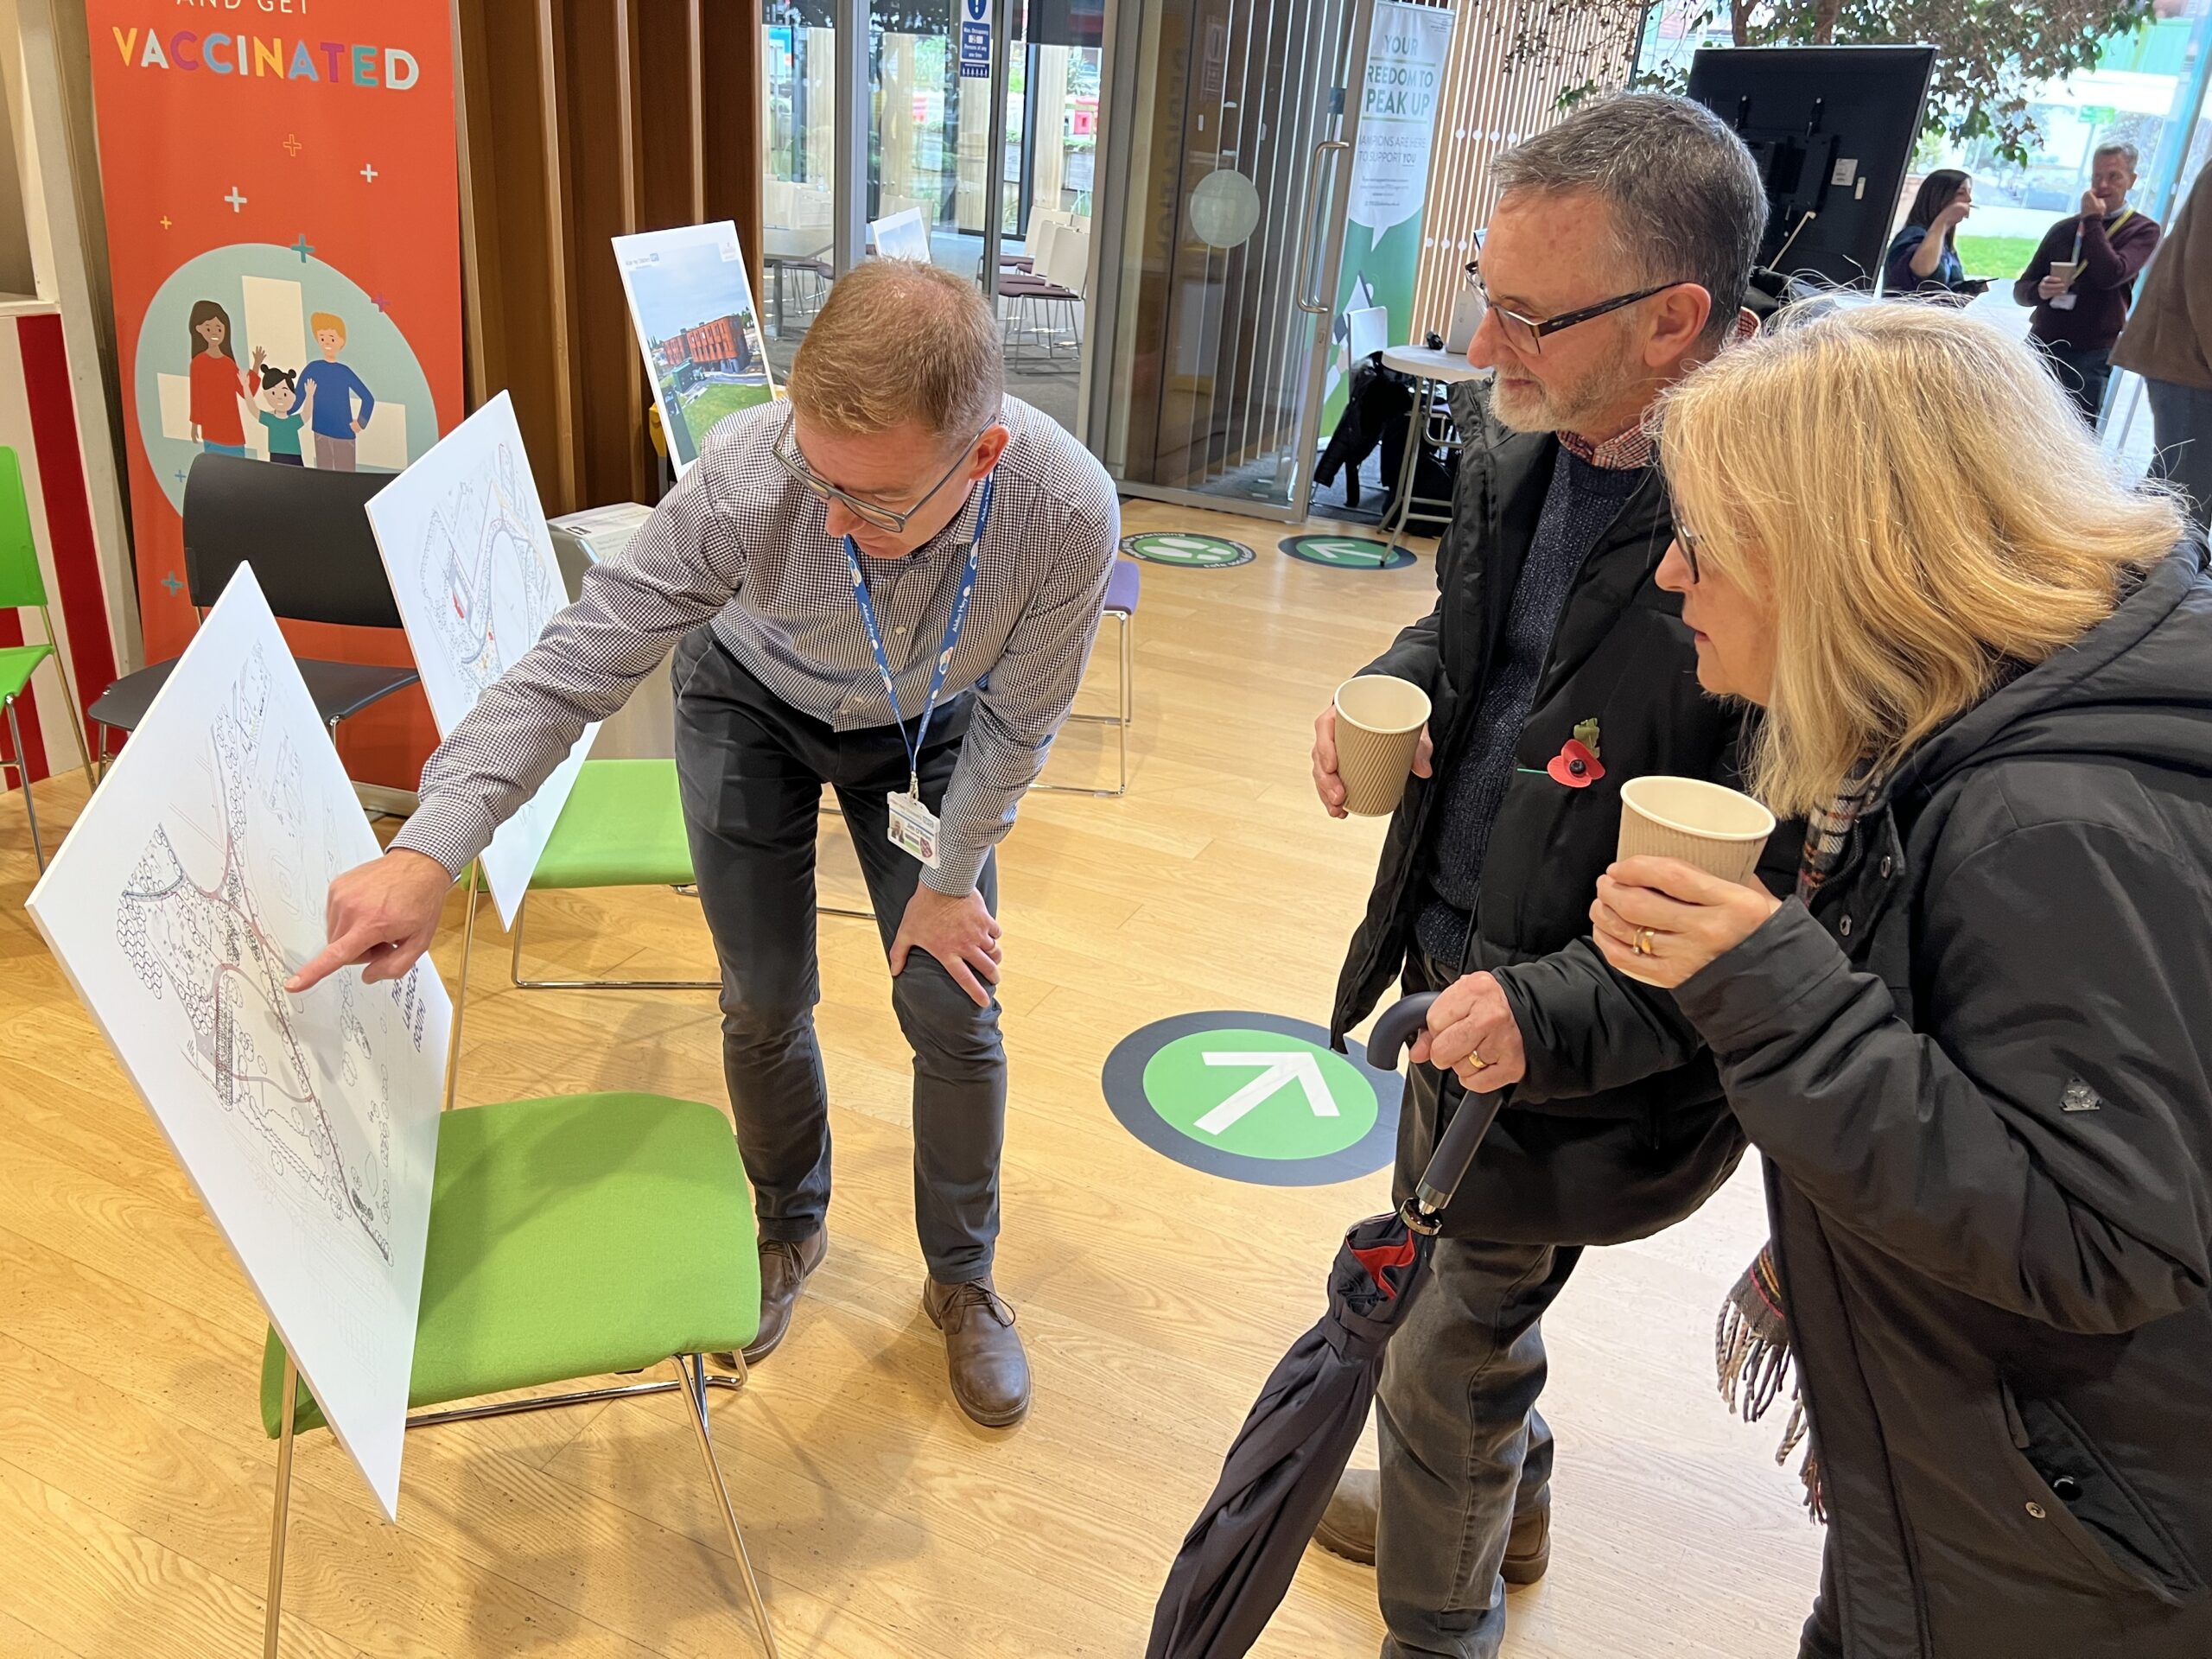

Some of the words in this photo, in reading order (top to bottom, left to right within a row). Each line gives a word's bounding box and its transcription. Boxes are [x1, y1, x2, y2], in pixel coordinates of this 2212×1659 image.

[1384, 35, 1418, 55] YOUR
[112, 27, 419, 90] VACCINATED
[1367, 65, 1417, 86] REEDOM
[1419, 70, 1434, 87] TO
[1365, 88, 1408, 115] PEAK
[1410, 92, 1431, 116] UP
[1402, 153, 1417, 163] YOU
[413, 998, 426, 1053] (SOUTH)
